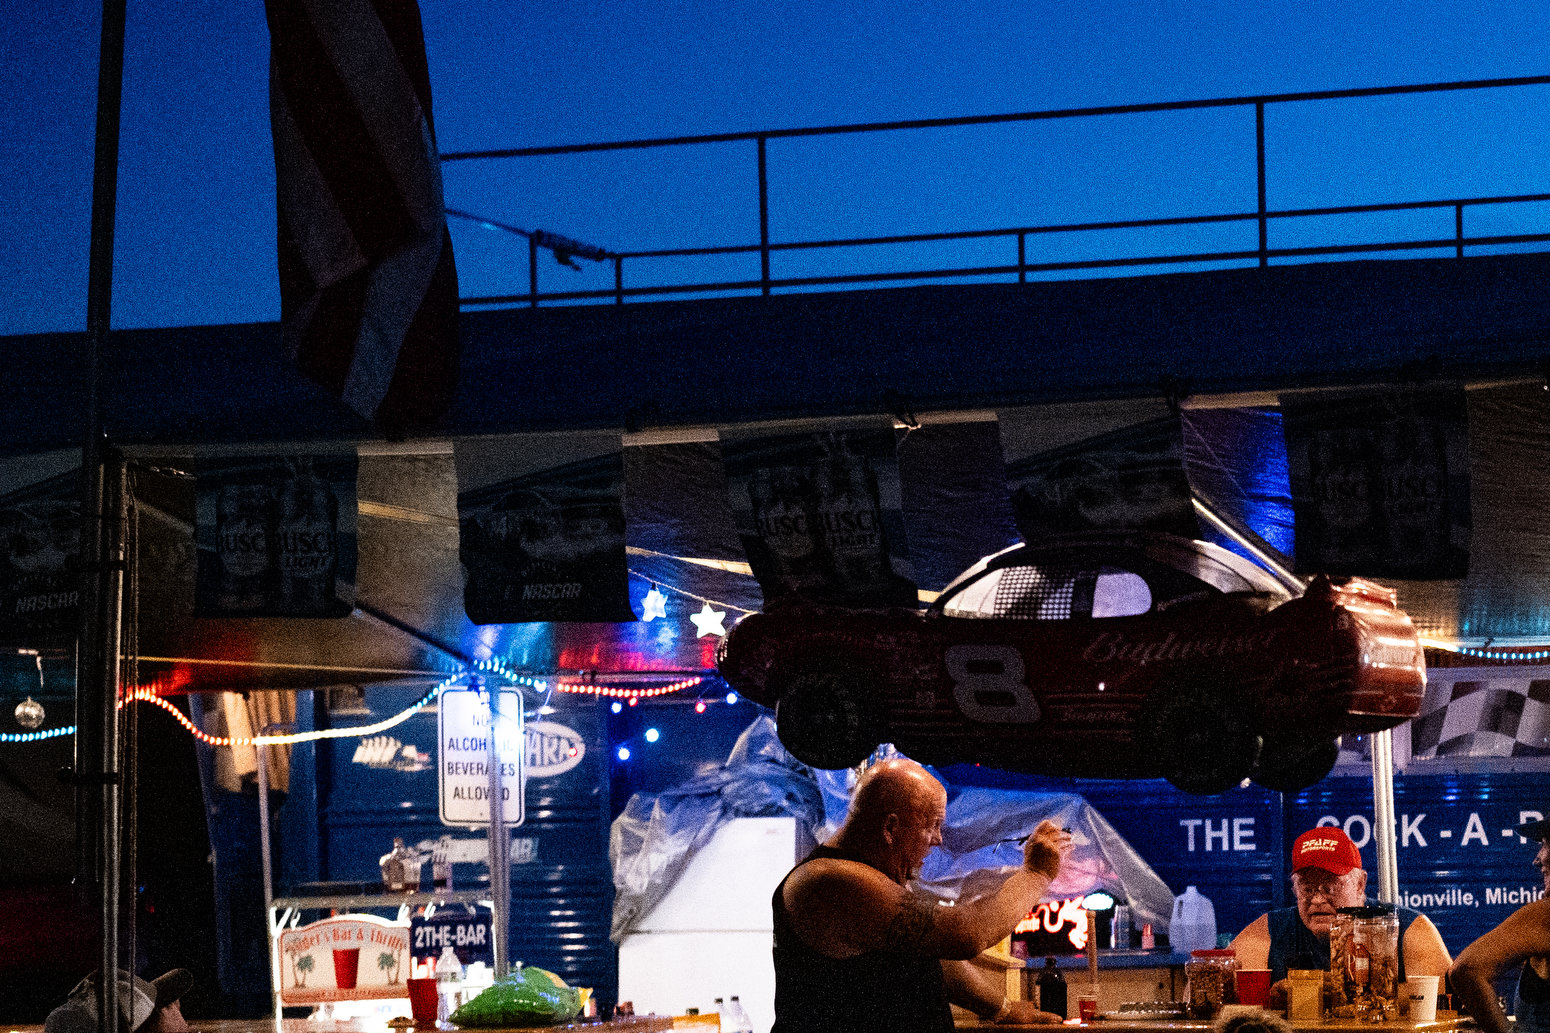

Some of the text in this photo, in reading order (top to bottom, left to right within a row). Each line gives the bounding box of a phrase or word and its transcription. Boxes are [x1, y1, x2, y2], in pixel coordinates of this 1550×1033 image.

[523, 582, 583, 601] NASCAR
[15, 592, 79, 613] NASCAR
[944, 643, 1042, 725] 8
[447, 762, 516, 777] BEVERAES
[1180, 817, 1257, 851] THE
[1302, 838, 1339, 849] PFAFF
[1378, 889, 1479, 908] nionville,
[415, 924, 487, 948] 2THE-BAR
